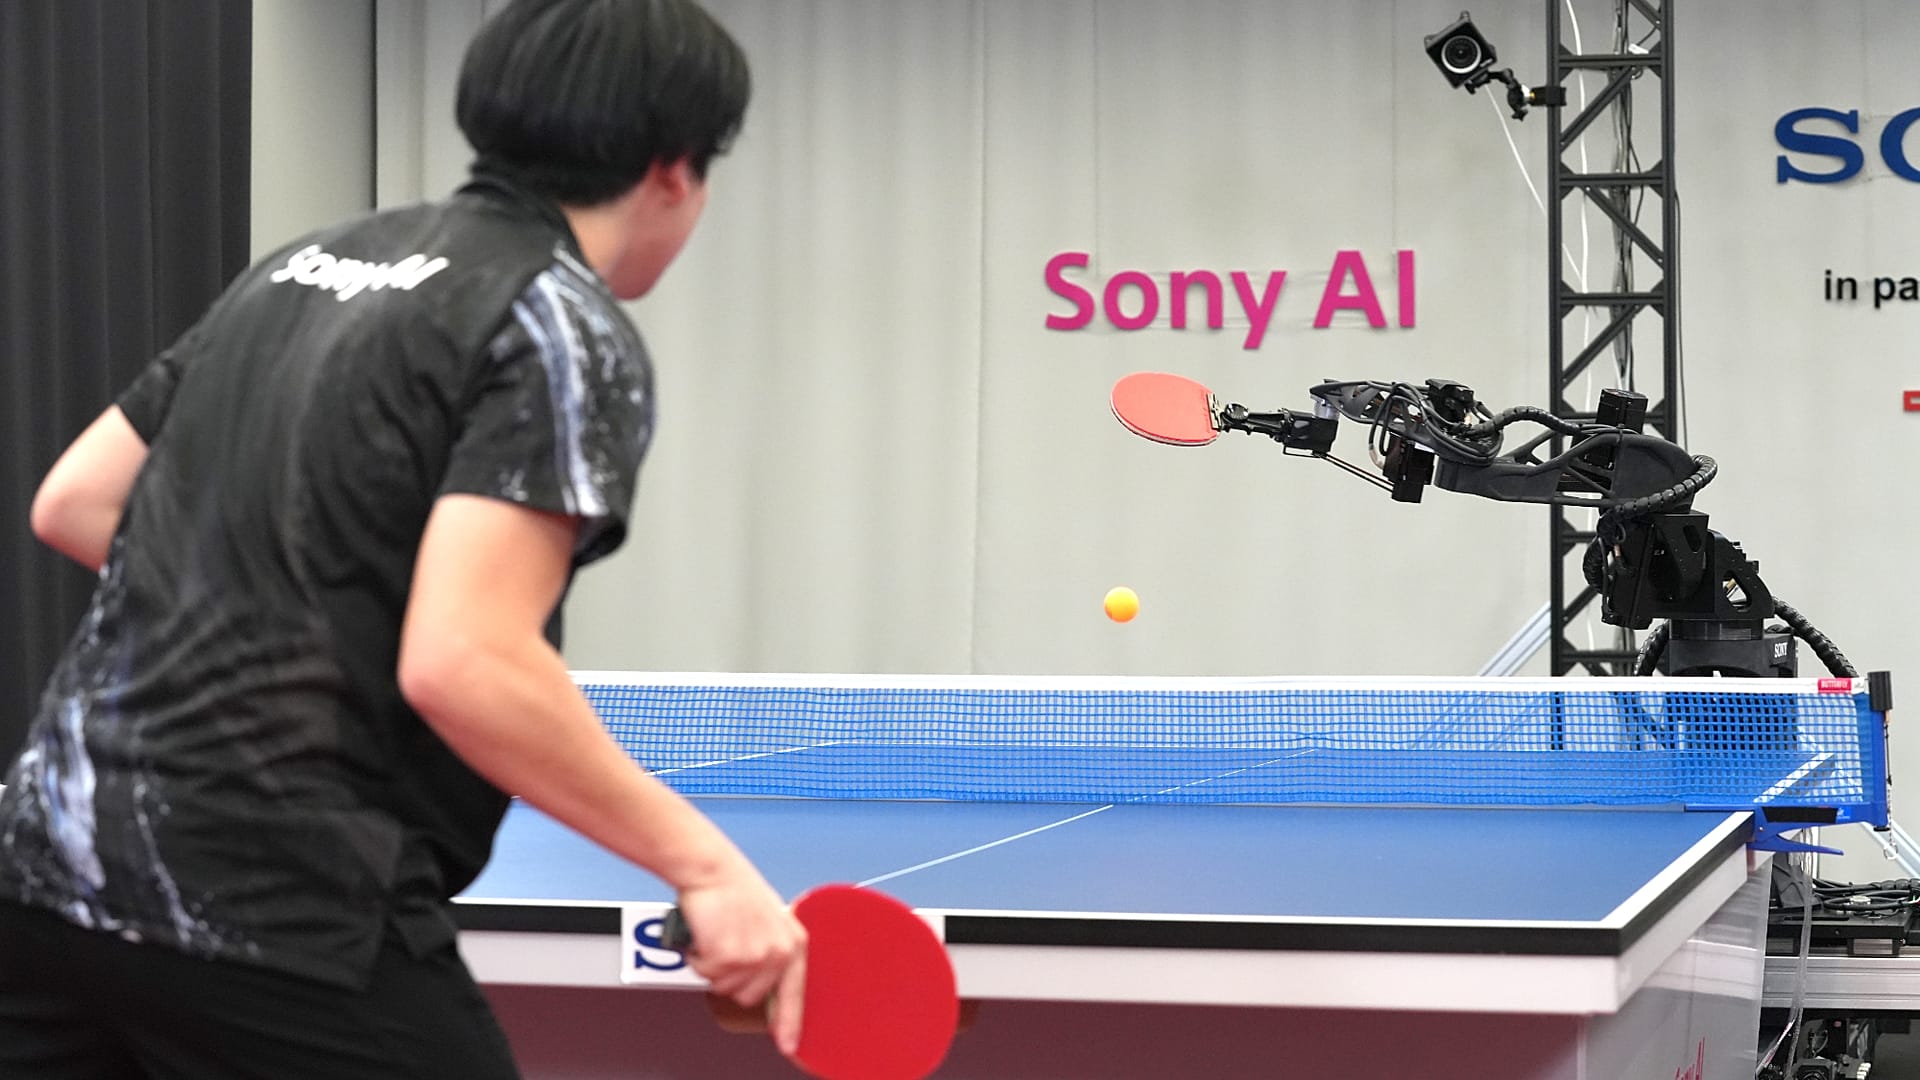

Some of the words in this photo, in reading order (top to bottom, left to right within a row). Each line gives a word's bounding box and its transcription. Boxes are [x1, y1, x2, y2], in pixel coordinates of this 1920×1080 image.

[1044, 251, 1288, 350] Sony
[1313, 250, 1415, 329] AI
[1824, 269, 1857, 301] in
